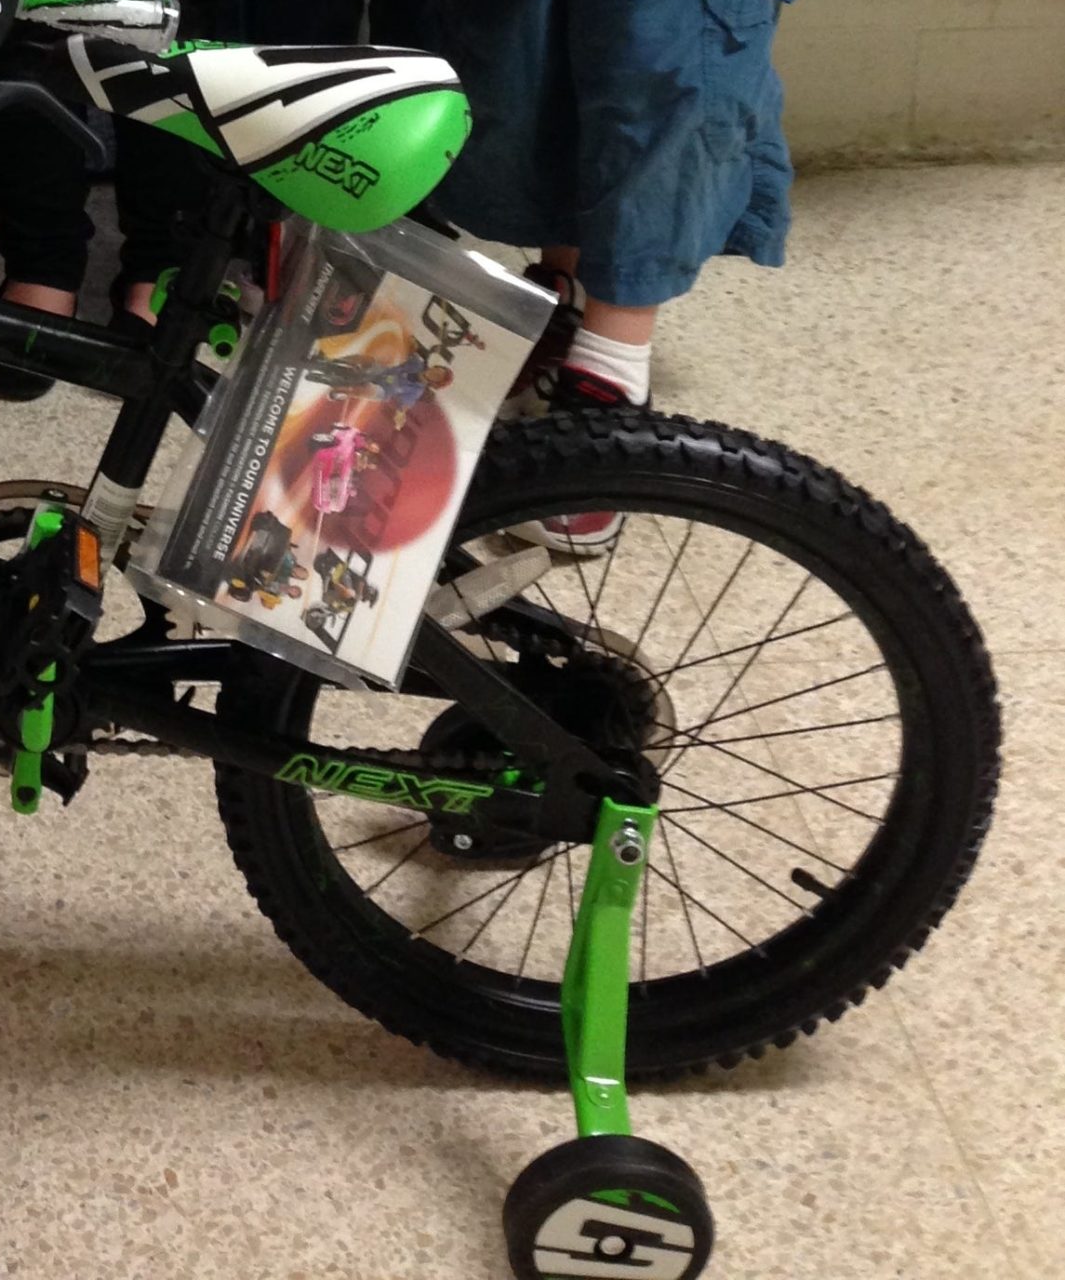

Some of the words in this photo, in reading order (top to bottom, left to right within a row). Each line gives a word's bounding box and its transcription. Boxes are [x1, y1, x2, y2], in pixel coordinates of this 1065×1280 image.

[294, 141, 381, 200] NEXT
[261, 364, 297, 435] WELCOME
[240, 457, 262, 490] OUR
[252, 435, 270, 457] TO
[212, 490, 249, 562] UNIVERSE
[273, 753, 494, 815] NEXT
